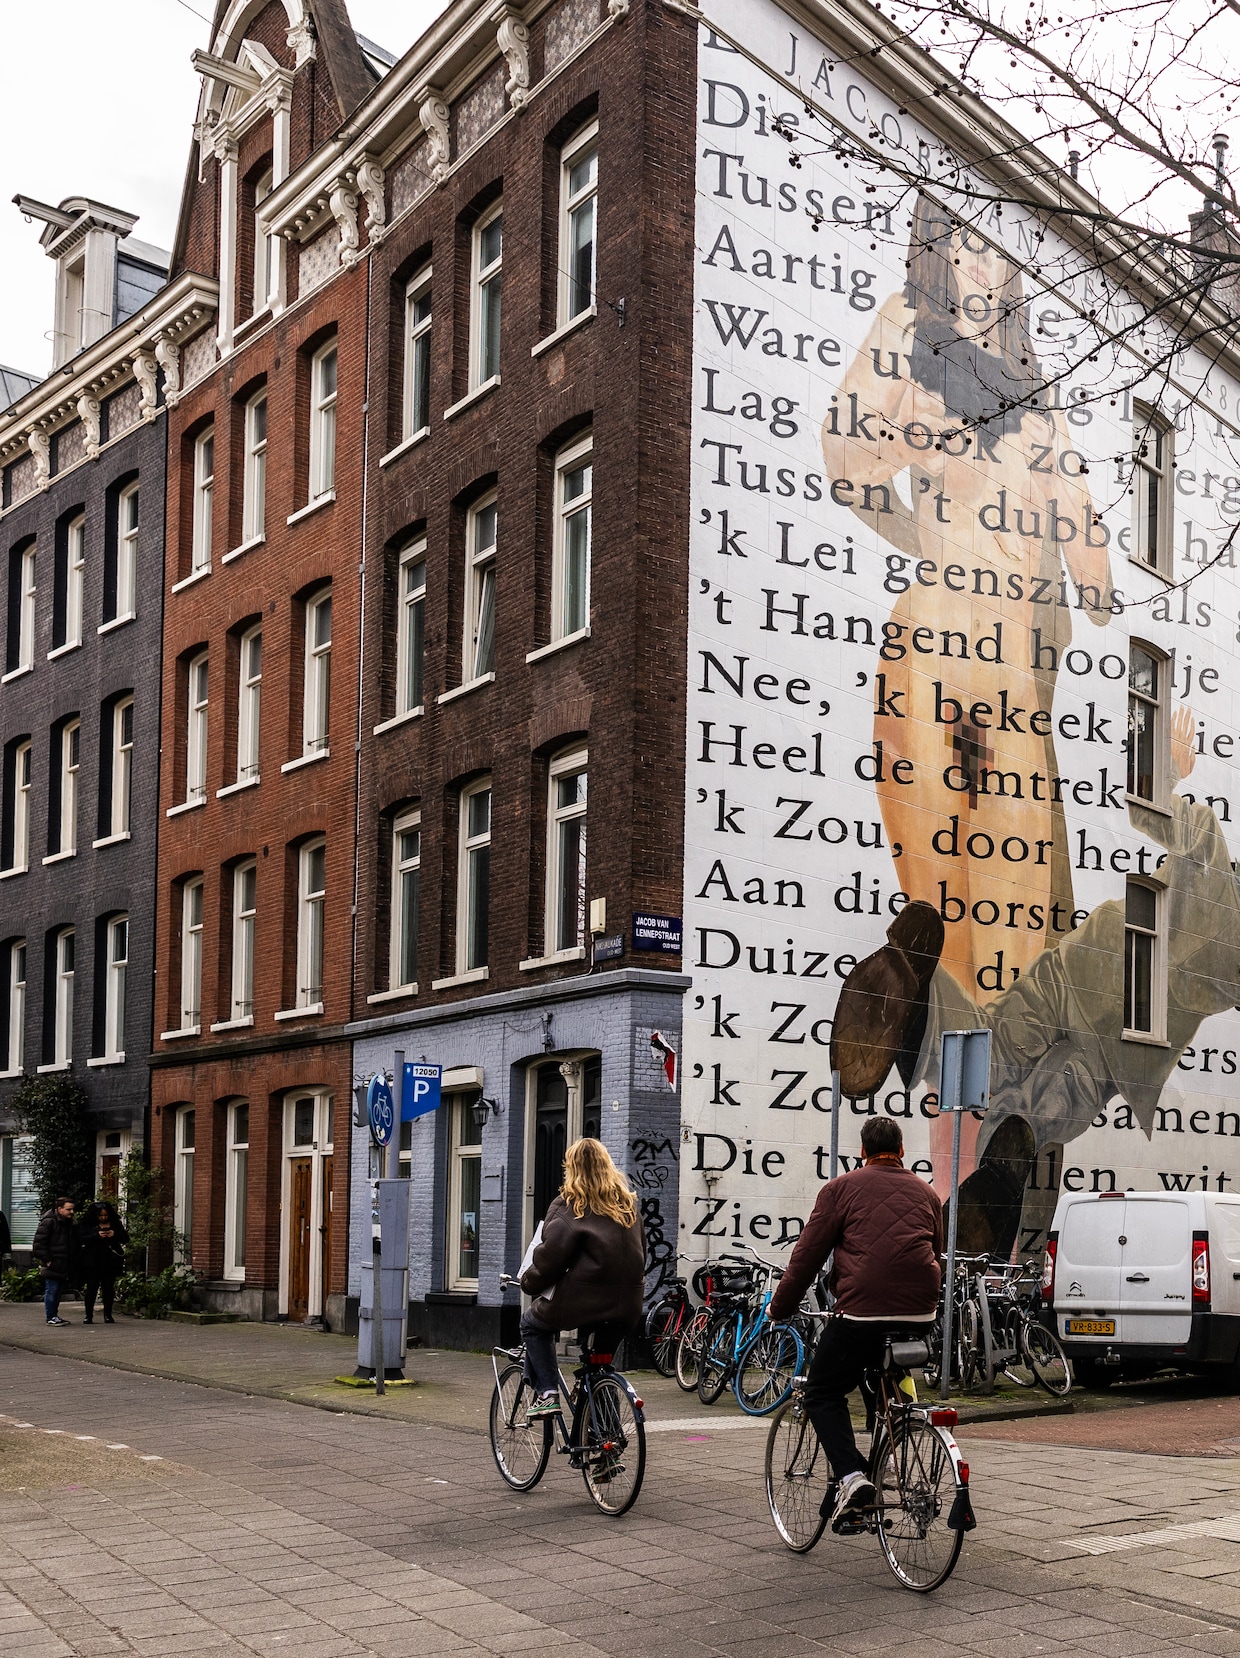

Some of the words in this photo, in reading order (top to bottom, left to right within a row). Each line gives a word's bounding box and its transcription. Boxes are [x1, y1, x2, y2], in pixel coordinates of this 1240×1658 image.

[702, 78, 800, 141] Die
[785, 32, 931, 178] JACOB
[702, 147, 895, 236] Tussen
[701, 224, 877, 312] Aartig
[702, 298, 841, 367] Ware
[700, 367, 800, 438] Lag
[827, 392, 877, 442] ik
[1027, 442, 1085, 478] zo
[700, 438, 894, 515] Tussen
[775, 520, 857, 576] Lei
[883, 552, 1126, 616] geenszins
[1151, 583, 1213, 629] als
[759, 588, 1004, 664] Hangend
[697, 650, 831, 717] Nee,
[696, 720, 826, 778] Heel
[854, 740, 914, 786] de
[943, 763, 1125, 810] omtrek
[773, 796, 903, 859] Zou,
[931, 814, 1054, 866] door
[636, 916, 656, 927] JACOB
[657, 919, 669, 928] VAN
[695, 858, 806, 908] Aan
[833, 871, 911, 917] die
[635, 928, 680, 942] LENNEPSTRAAT
[413, 1080, 430, 1103] P
[414, 1067, 438, 1077] 12050
[691, 1133, 786, 1178] Die
[1158, 1165, 1231, 1192] wit
